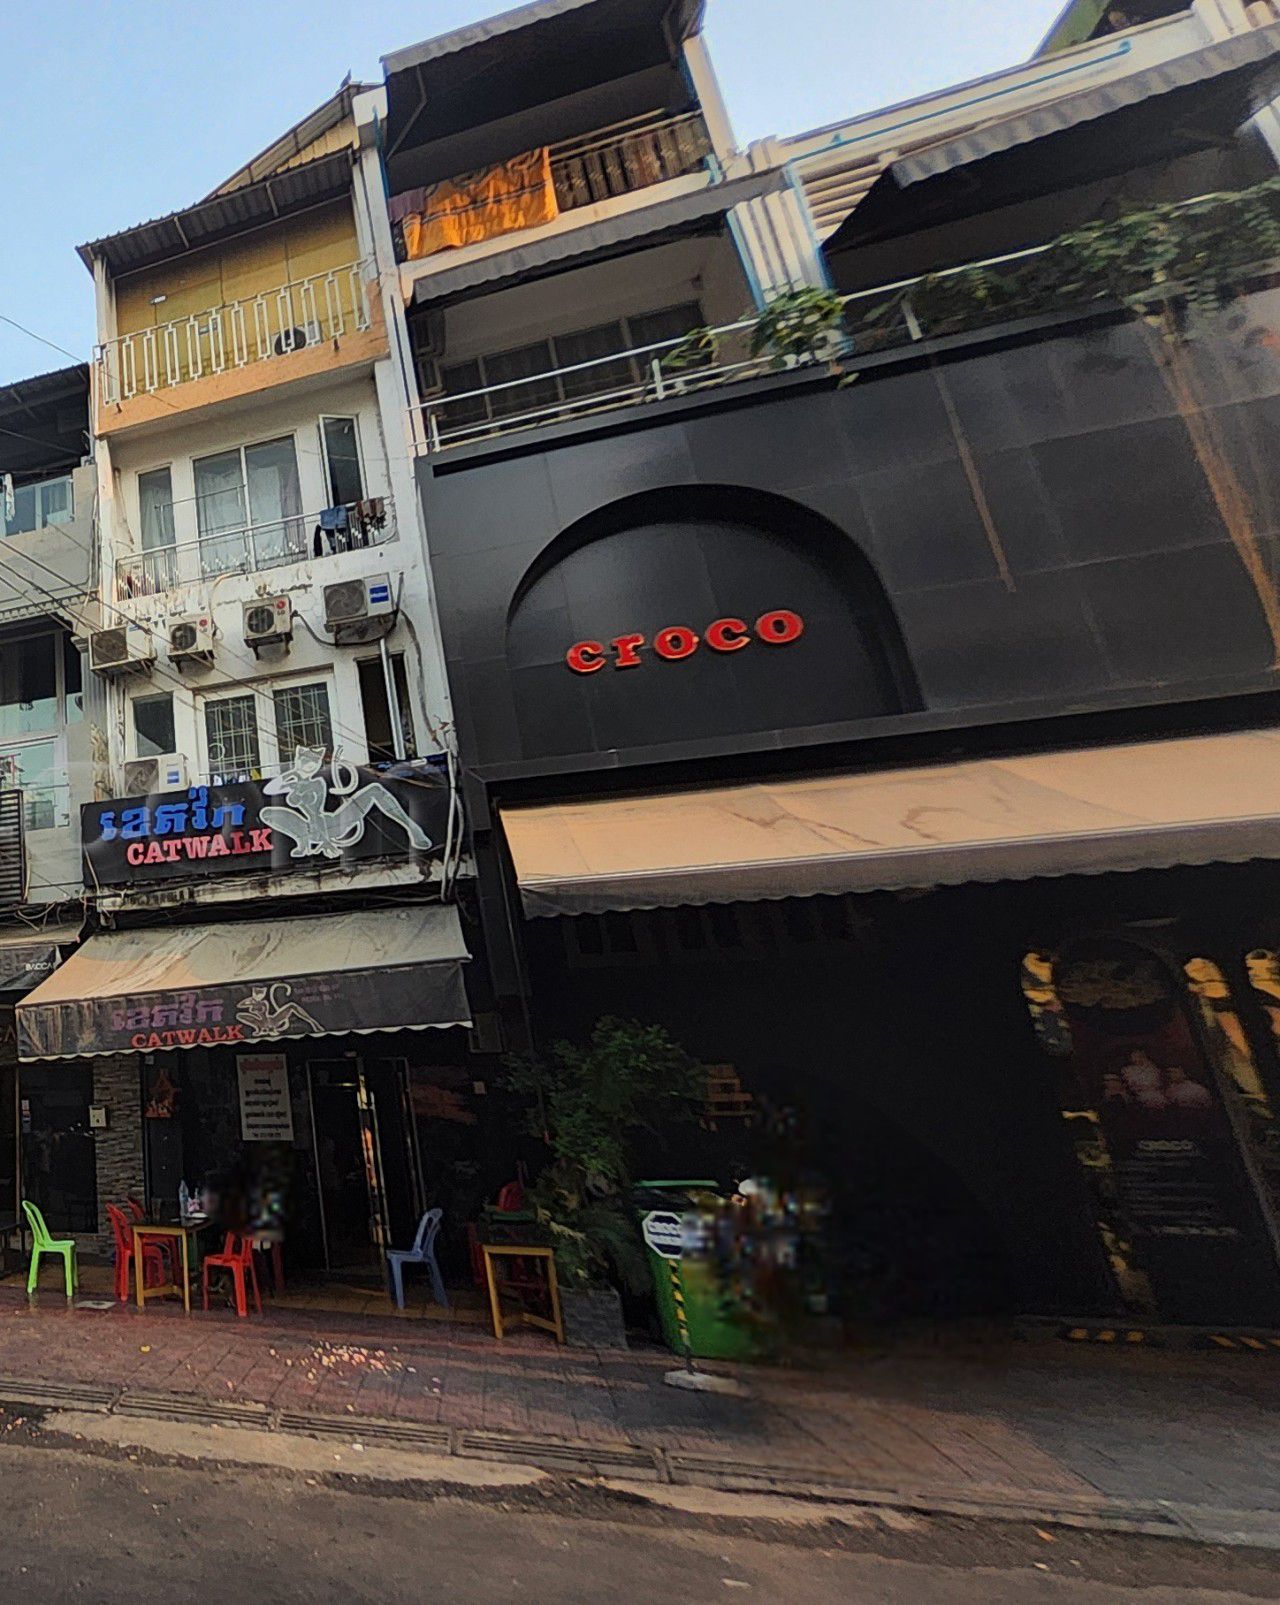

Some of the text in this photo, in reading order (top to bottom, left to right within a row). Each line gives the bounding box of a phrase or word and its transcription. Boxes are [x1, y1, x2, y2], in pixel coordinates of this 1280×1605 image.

[564, 608, 805, 676] croco
[126, 827, 275, 867] CATWALK
[130, 1023, 246, 1048] CATWALK
